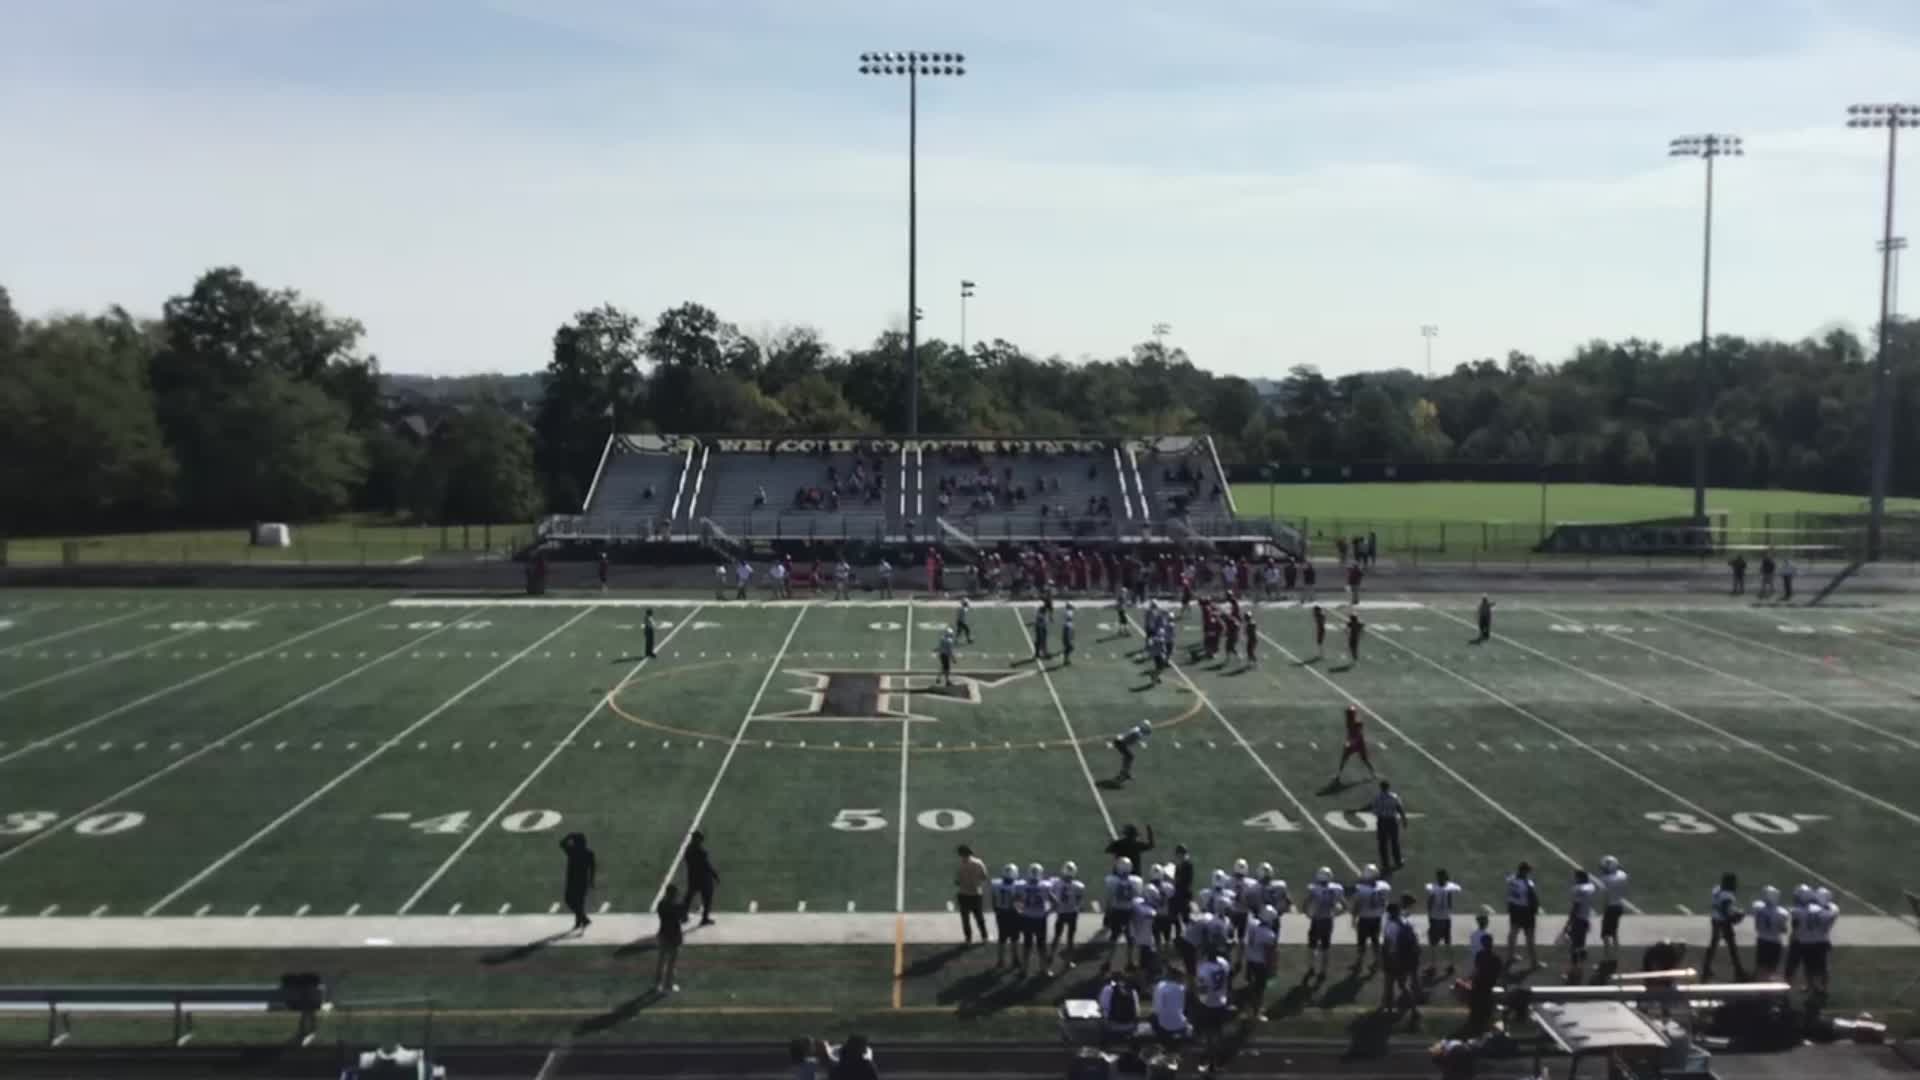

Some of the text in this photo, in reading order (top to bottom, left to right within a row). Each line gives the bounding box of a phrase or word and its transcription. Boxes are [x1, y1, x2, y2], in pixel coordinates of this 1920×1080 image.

[409, 809, 563, 834] 40
[830, 808, 974, 831] 50
[1644, 811, 1800, 834] 30
